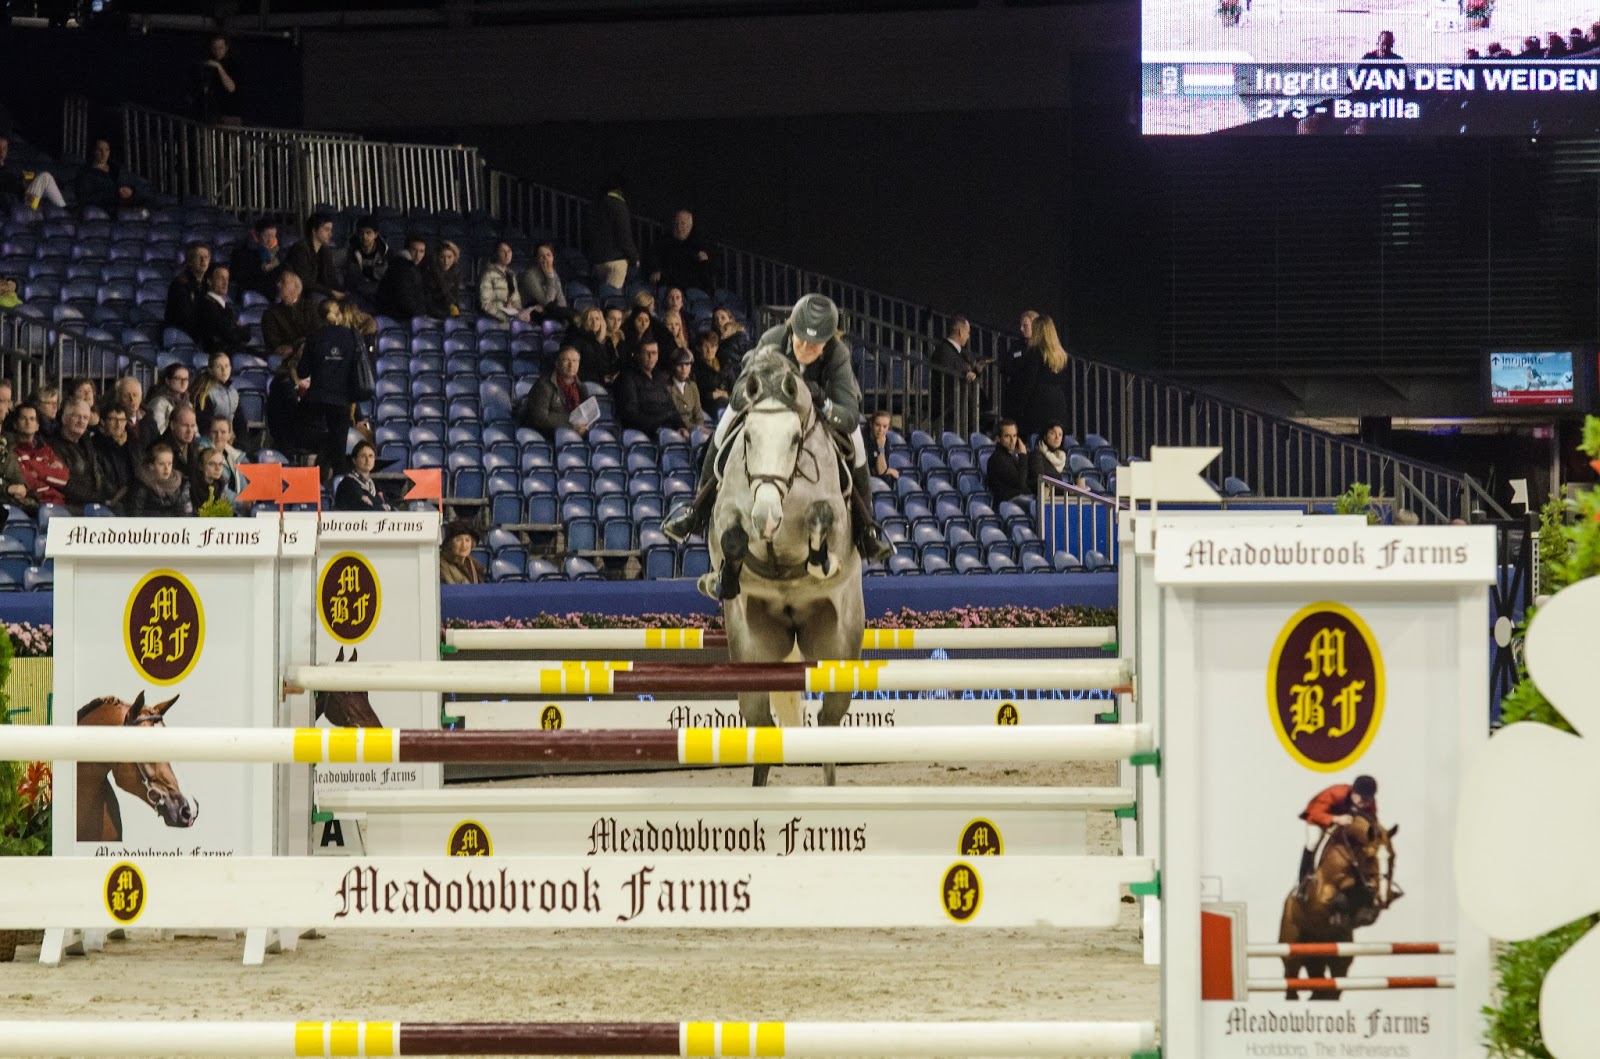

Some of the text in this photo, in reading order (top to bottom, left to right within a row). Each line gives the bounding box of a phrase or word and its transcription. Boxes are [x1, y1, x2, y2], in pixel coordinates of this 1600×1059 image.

[1256, 67, 1599, 96] Ingrid VAN DEN WEIDEN
[1257, 99, 1309, 119] 273
[1334, 98, 1420, 119] Barilla
[65, 525, 191, 546] Meadowbrook
[196, 526, 261, 549] Farms
[373, 518, 425, 534] Farms
[1184, 538, 1469, 570] Meadowbrook Farms
[314, 767, 417, 785] eadowbrook Farms
[320, 819, 345, 847] A
[587, 816, 867, 856] Meadowbrook Farms
[334, 864, 752, 923] Meadowbrook Farms
[1225, 1007, 1431, 1039] Meadowbrook Farms
